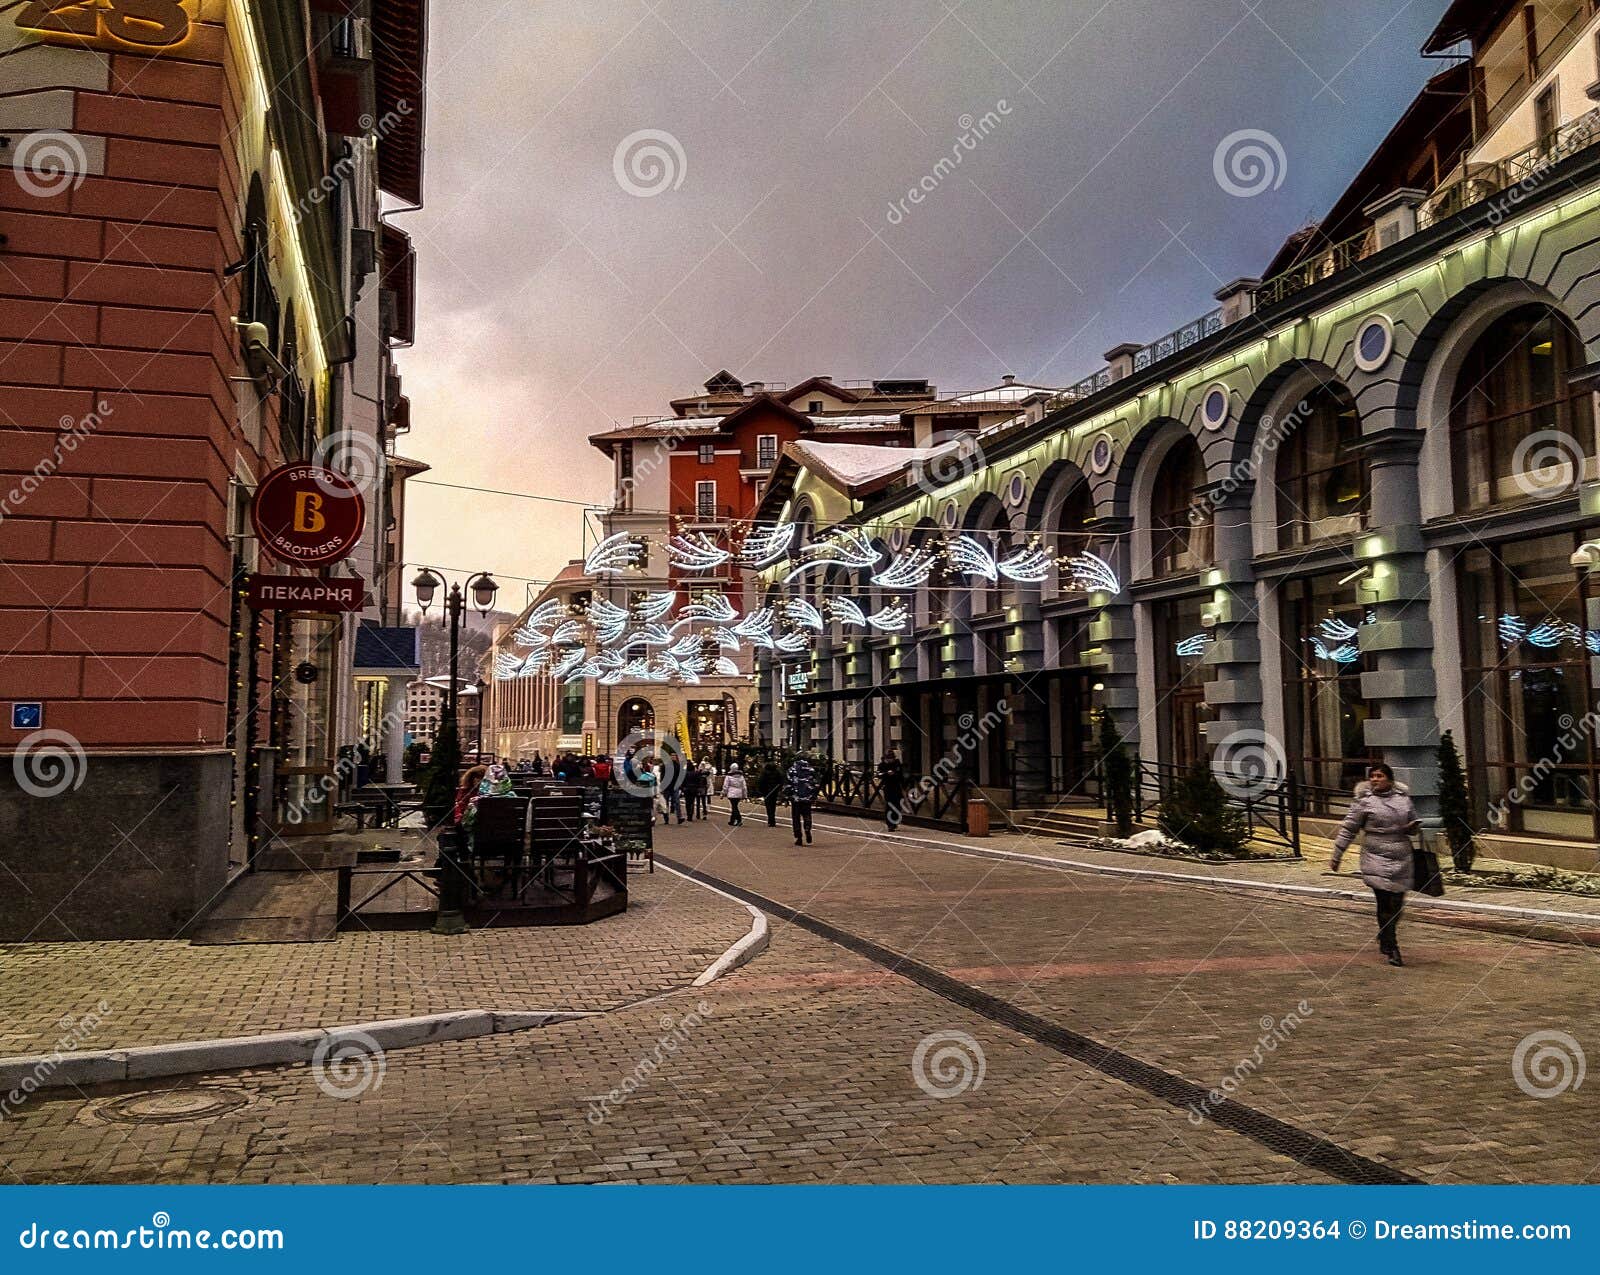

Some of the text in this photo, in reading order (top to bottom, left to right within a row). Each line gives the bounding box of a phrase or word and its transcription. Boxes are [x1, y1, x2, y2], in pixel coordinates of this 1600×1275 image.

[289, 469, 334, 485] BREAD
[294, 491, 325, 533] B
[275, 535, 343, 556] BROTHERS
[260, 585, 353, 602] ПЕКАРНЯ
